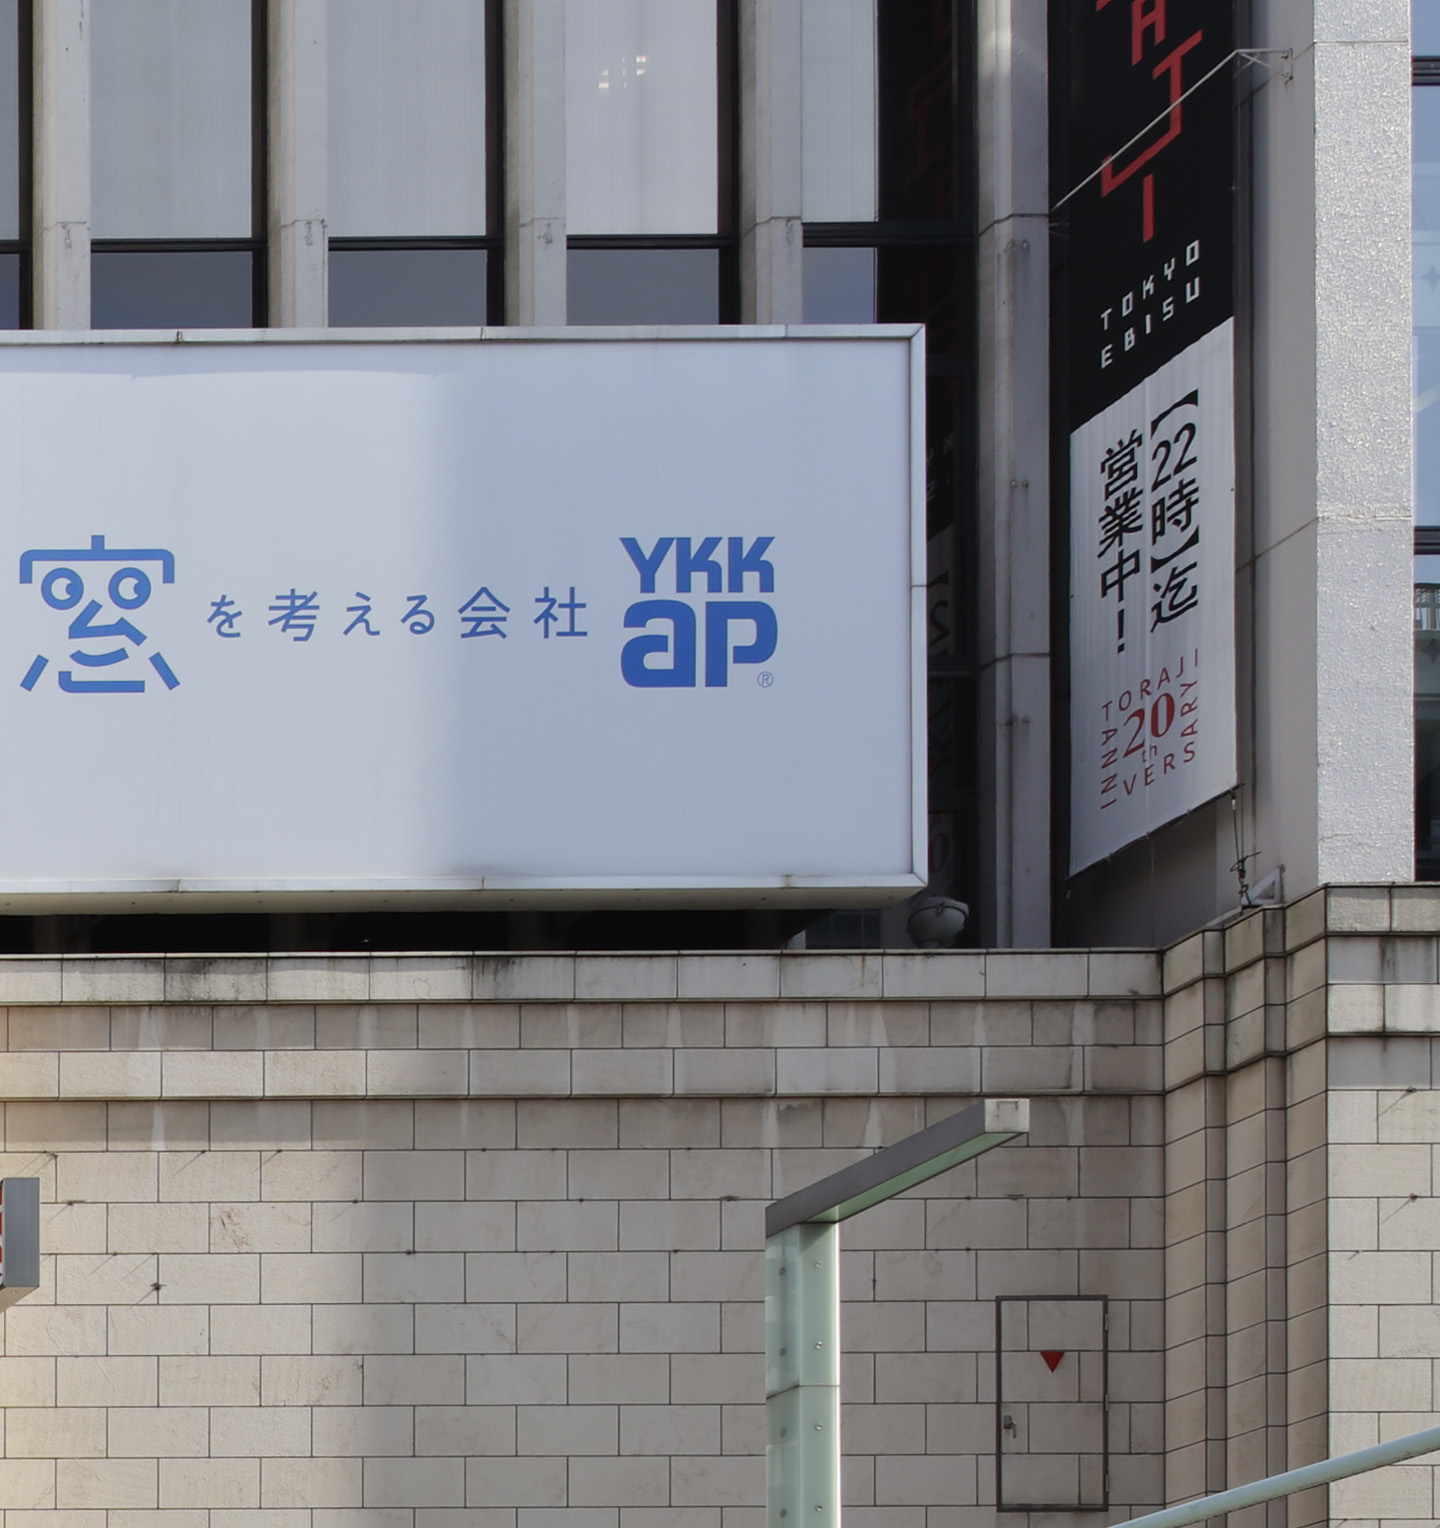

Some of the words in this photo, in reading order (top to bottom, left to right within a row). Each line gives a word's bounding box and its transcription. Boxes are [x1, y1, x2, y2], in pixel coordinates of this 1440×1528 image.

[1100, 240, 1201, 331] TOKYO
[1100, 276, 1201, 369] EBISU
[619, 536, 776, 593] YKK
